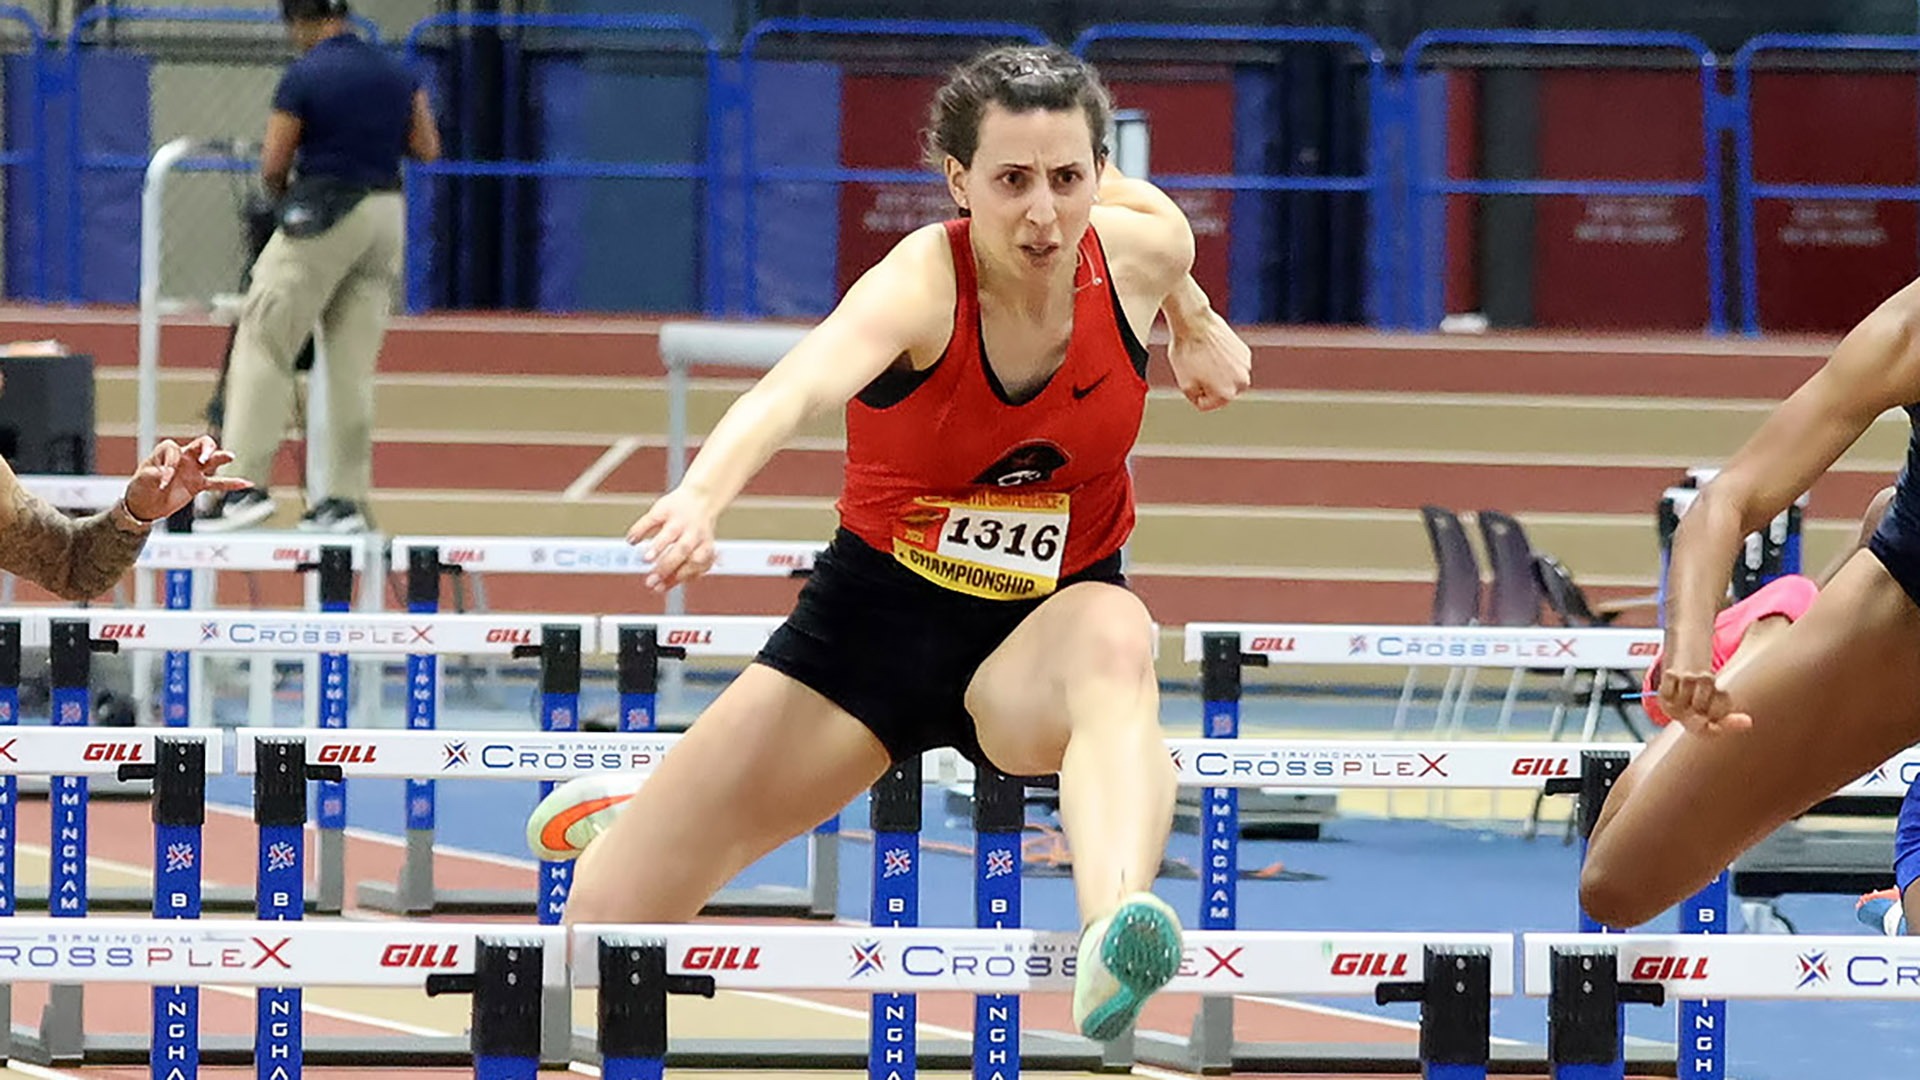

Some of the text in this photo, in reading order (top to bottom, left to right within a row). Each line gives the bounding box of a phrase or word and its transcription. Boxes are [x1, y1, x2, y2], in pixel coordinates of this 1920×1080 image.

[947, 518, 1060, 561] 1316
[910, 550, 1034, 594] CHAMPIONSHIP
[100, 624, 146, 638] GILL
[486, 629, 531, 644] GILL
[667, 630, 712, 645] GILL
[1250, 637, 1295, 651] GILL
[1376, 637, 1578, 658] CROSSPLEX
[83, 743, 143, 761] GILL
[318, 745, 376, 763] GILL
[482, 745, 666, 769] CROSSP
[1196, 753, 1448, 776] CROSSPLEX
[1511, 758, 1569, 776] GILL
[47, 934, 193, 944] BIRMINGHAM
[380, 944, 459, 967] GILL
[682, 947, 760, 970] GILL
[1331, 953, 1407, 976] GILL
[1632, 957, 1710, 979] GILL
